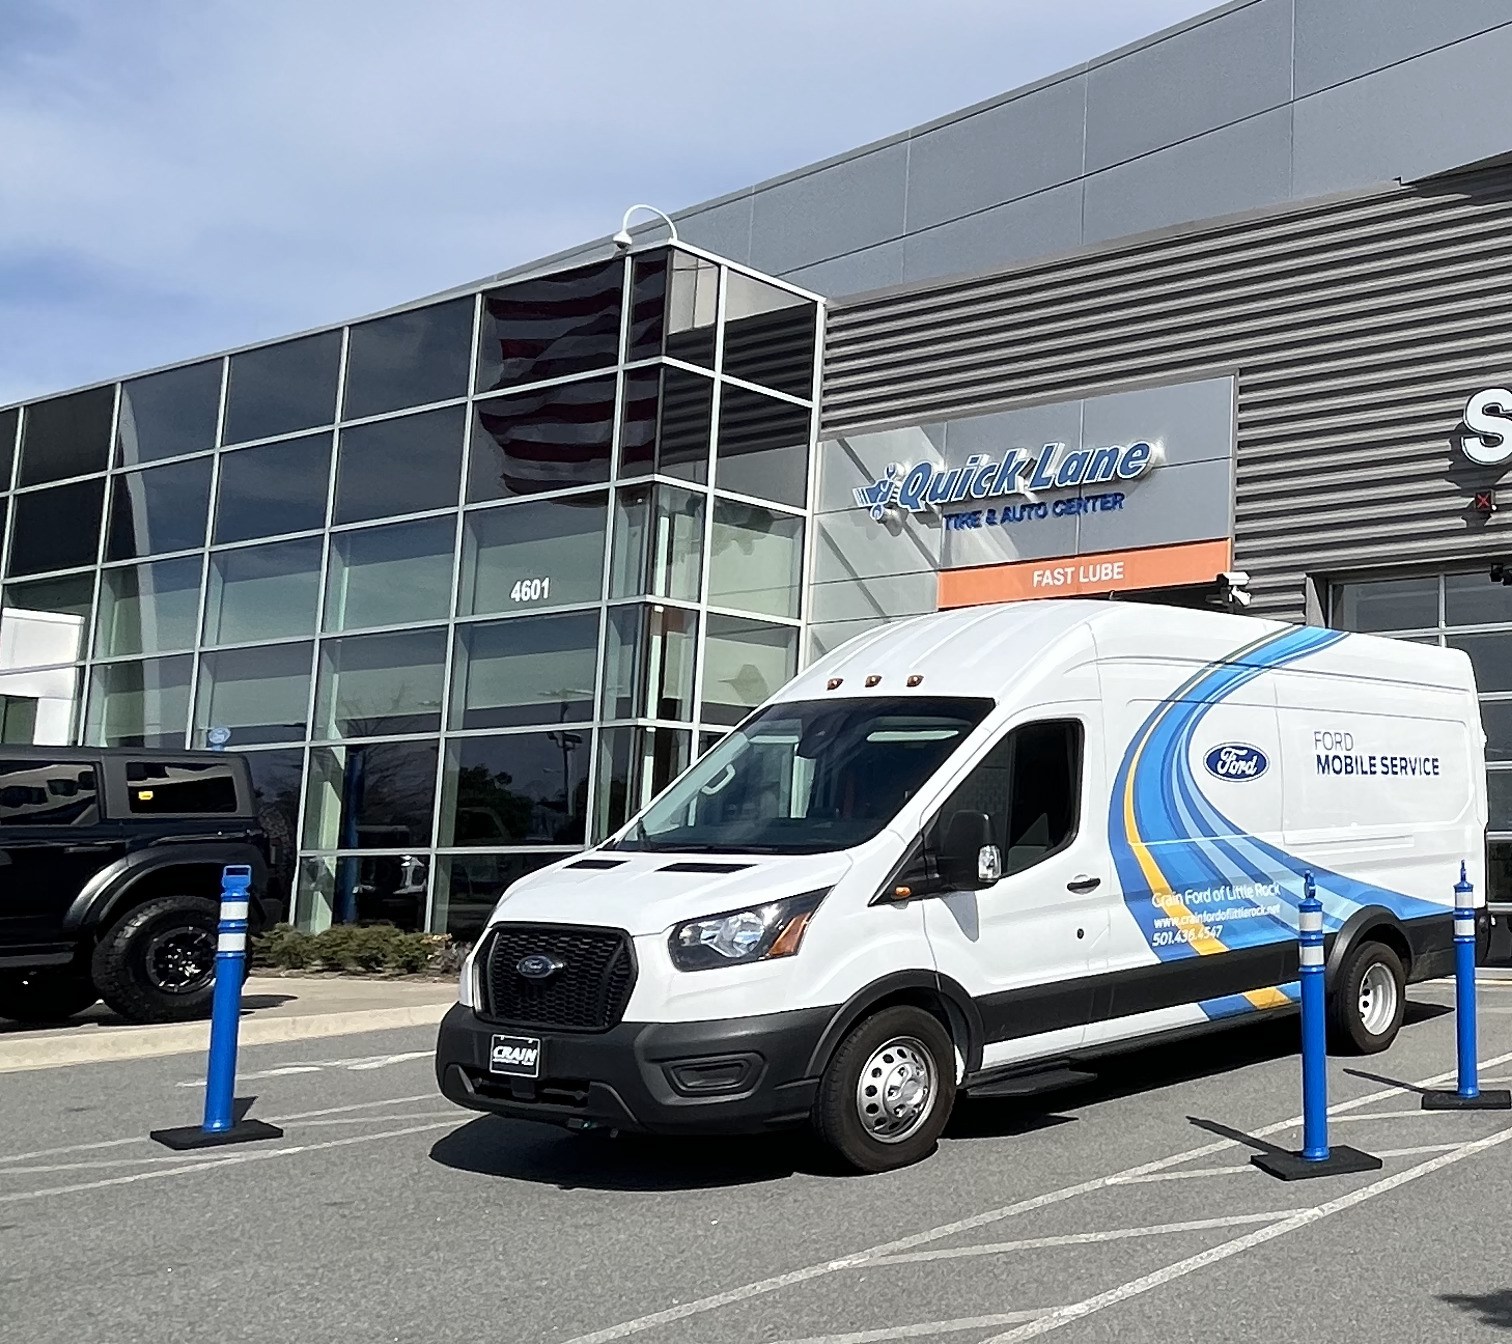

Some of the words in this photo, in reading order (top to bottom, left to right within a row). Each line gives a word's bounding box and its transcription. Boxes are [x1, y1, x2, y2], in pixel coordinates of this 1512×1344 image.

[897, 448, 1026, 513] Quick
[1027, 441, 1154, 490] Lane
[944, 509, 983, 531] TIRE
[986, 508, 998, 526] &
[1000, 502, 1049, 524] AUTO
[1054, 492, 1126, 516] CENTER
[1033, 566, 1076, 588] FAST
[1079, 562, 1125, 584] LUBE
[510, 577, 550, 602] 4601
[1313, 731, 1354, 752] FORD
[1216, 747, 1258, 775] Ford
[1316, 754, 1377, 776] MOBILE
[1381, 755, 1440, 776] SERVICE
[1151, 891, 1183, 908] Crain
[1185, 888, 1212, 905] Ford
[1214, 885, 1226, 902] of
[1227, 884, 1254, 901] Little
[1255, 882, 1281, 897] Rock
[493, 1046, 537, 1062] CRAIN
